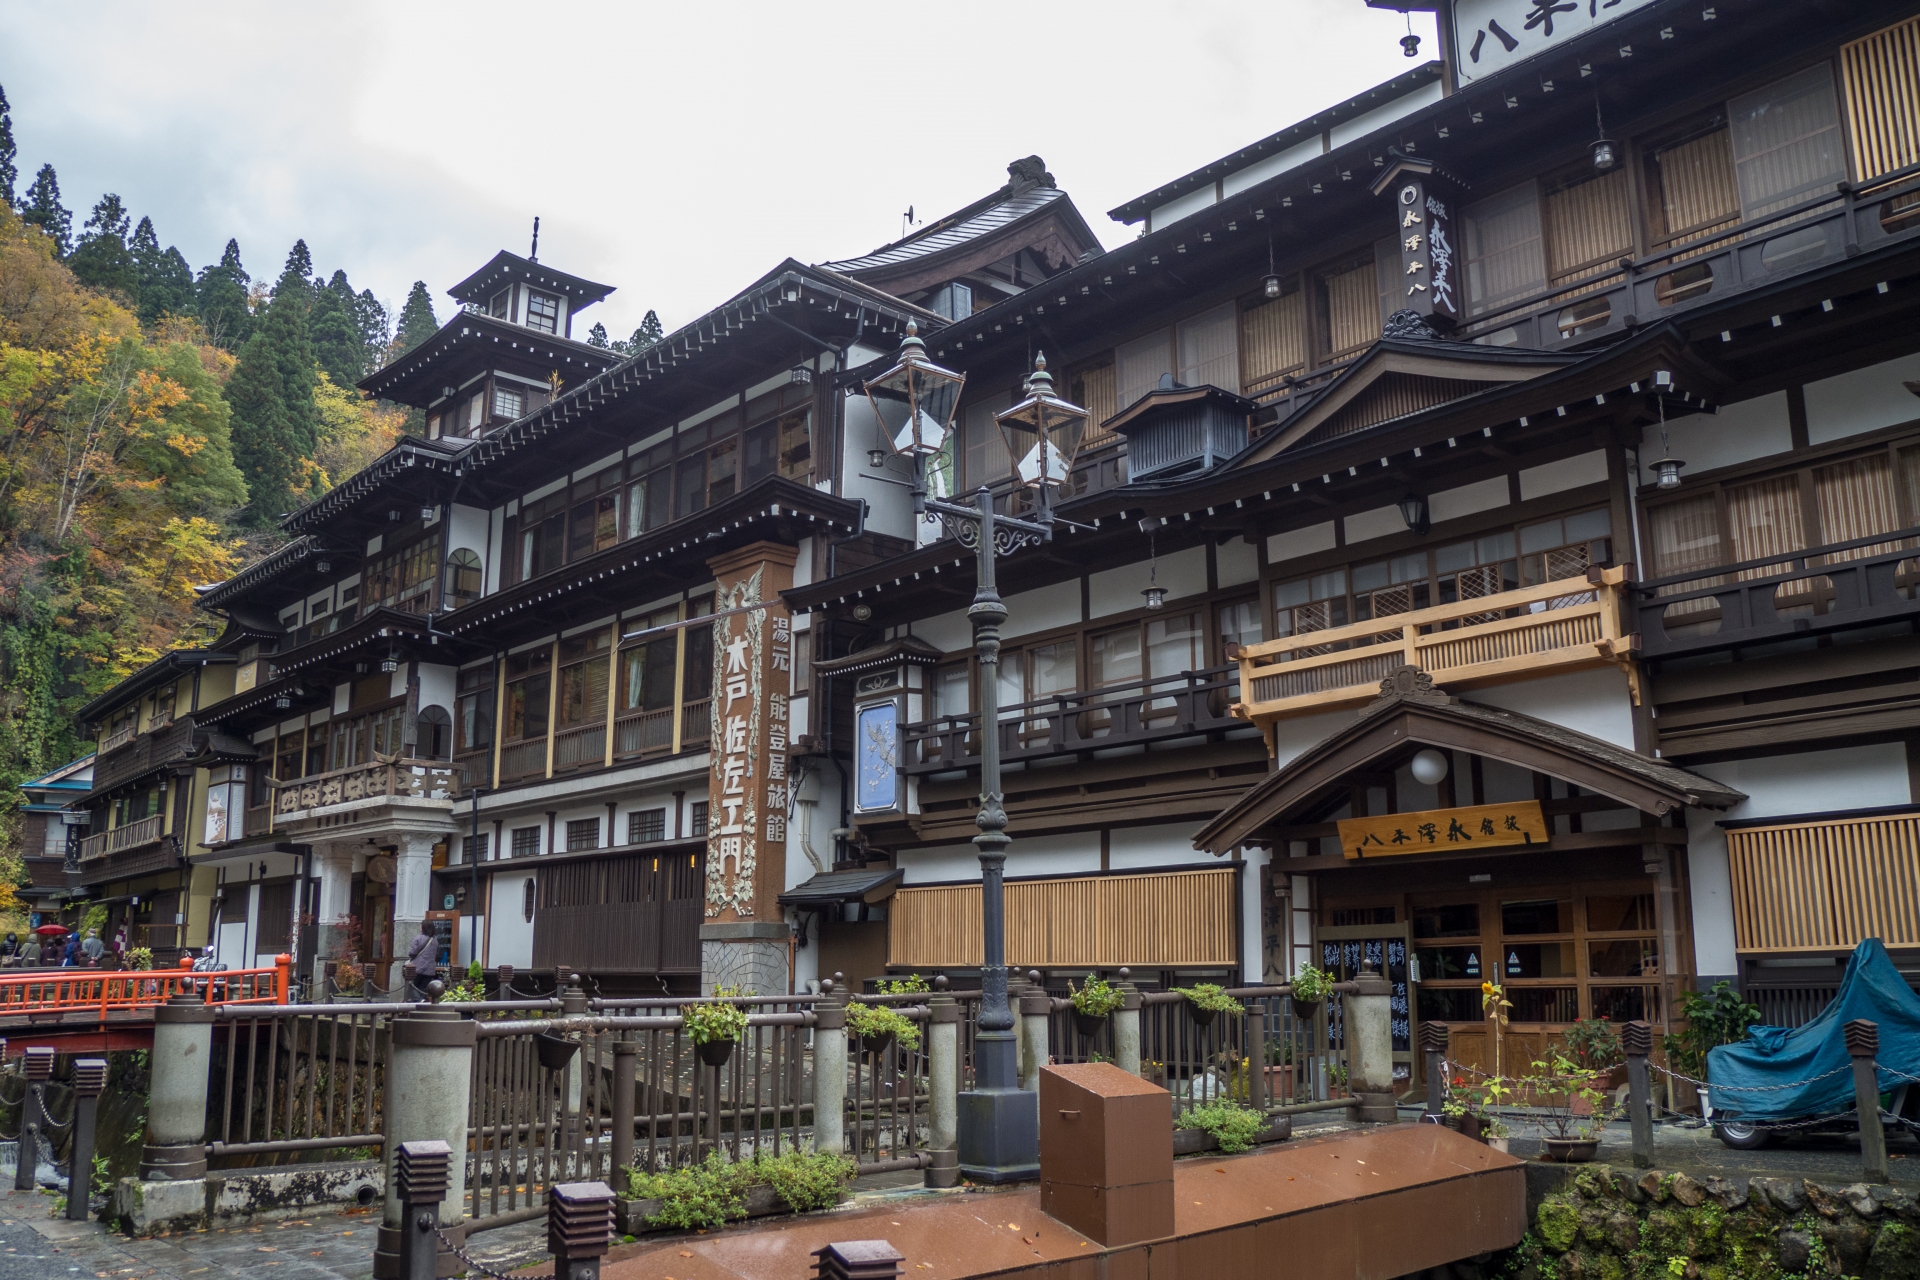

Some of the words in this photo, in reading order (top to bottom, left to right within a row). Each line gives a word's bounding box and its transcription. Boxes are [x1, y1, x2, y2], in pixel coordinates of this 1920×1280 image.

[771, 616, 789, 672] 湯元
[766, 692, 787, 843] 能登屋旅館
